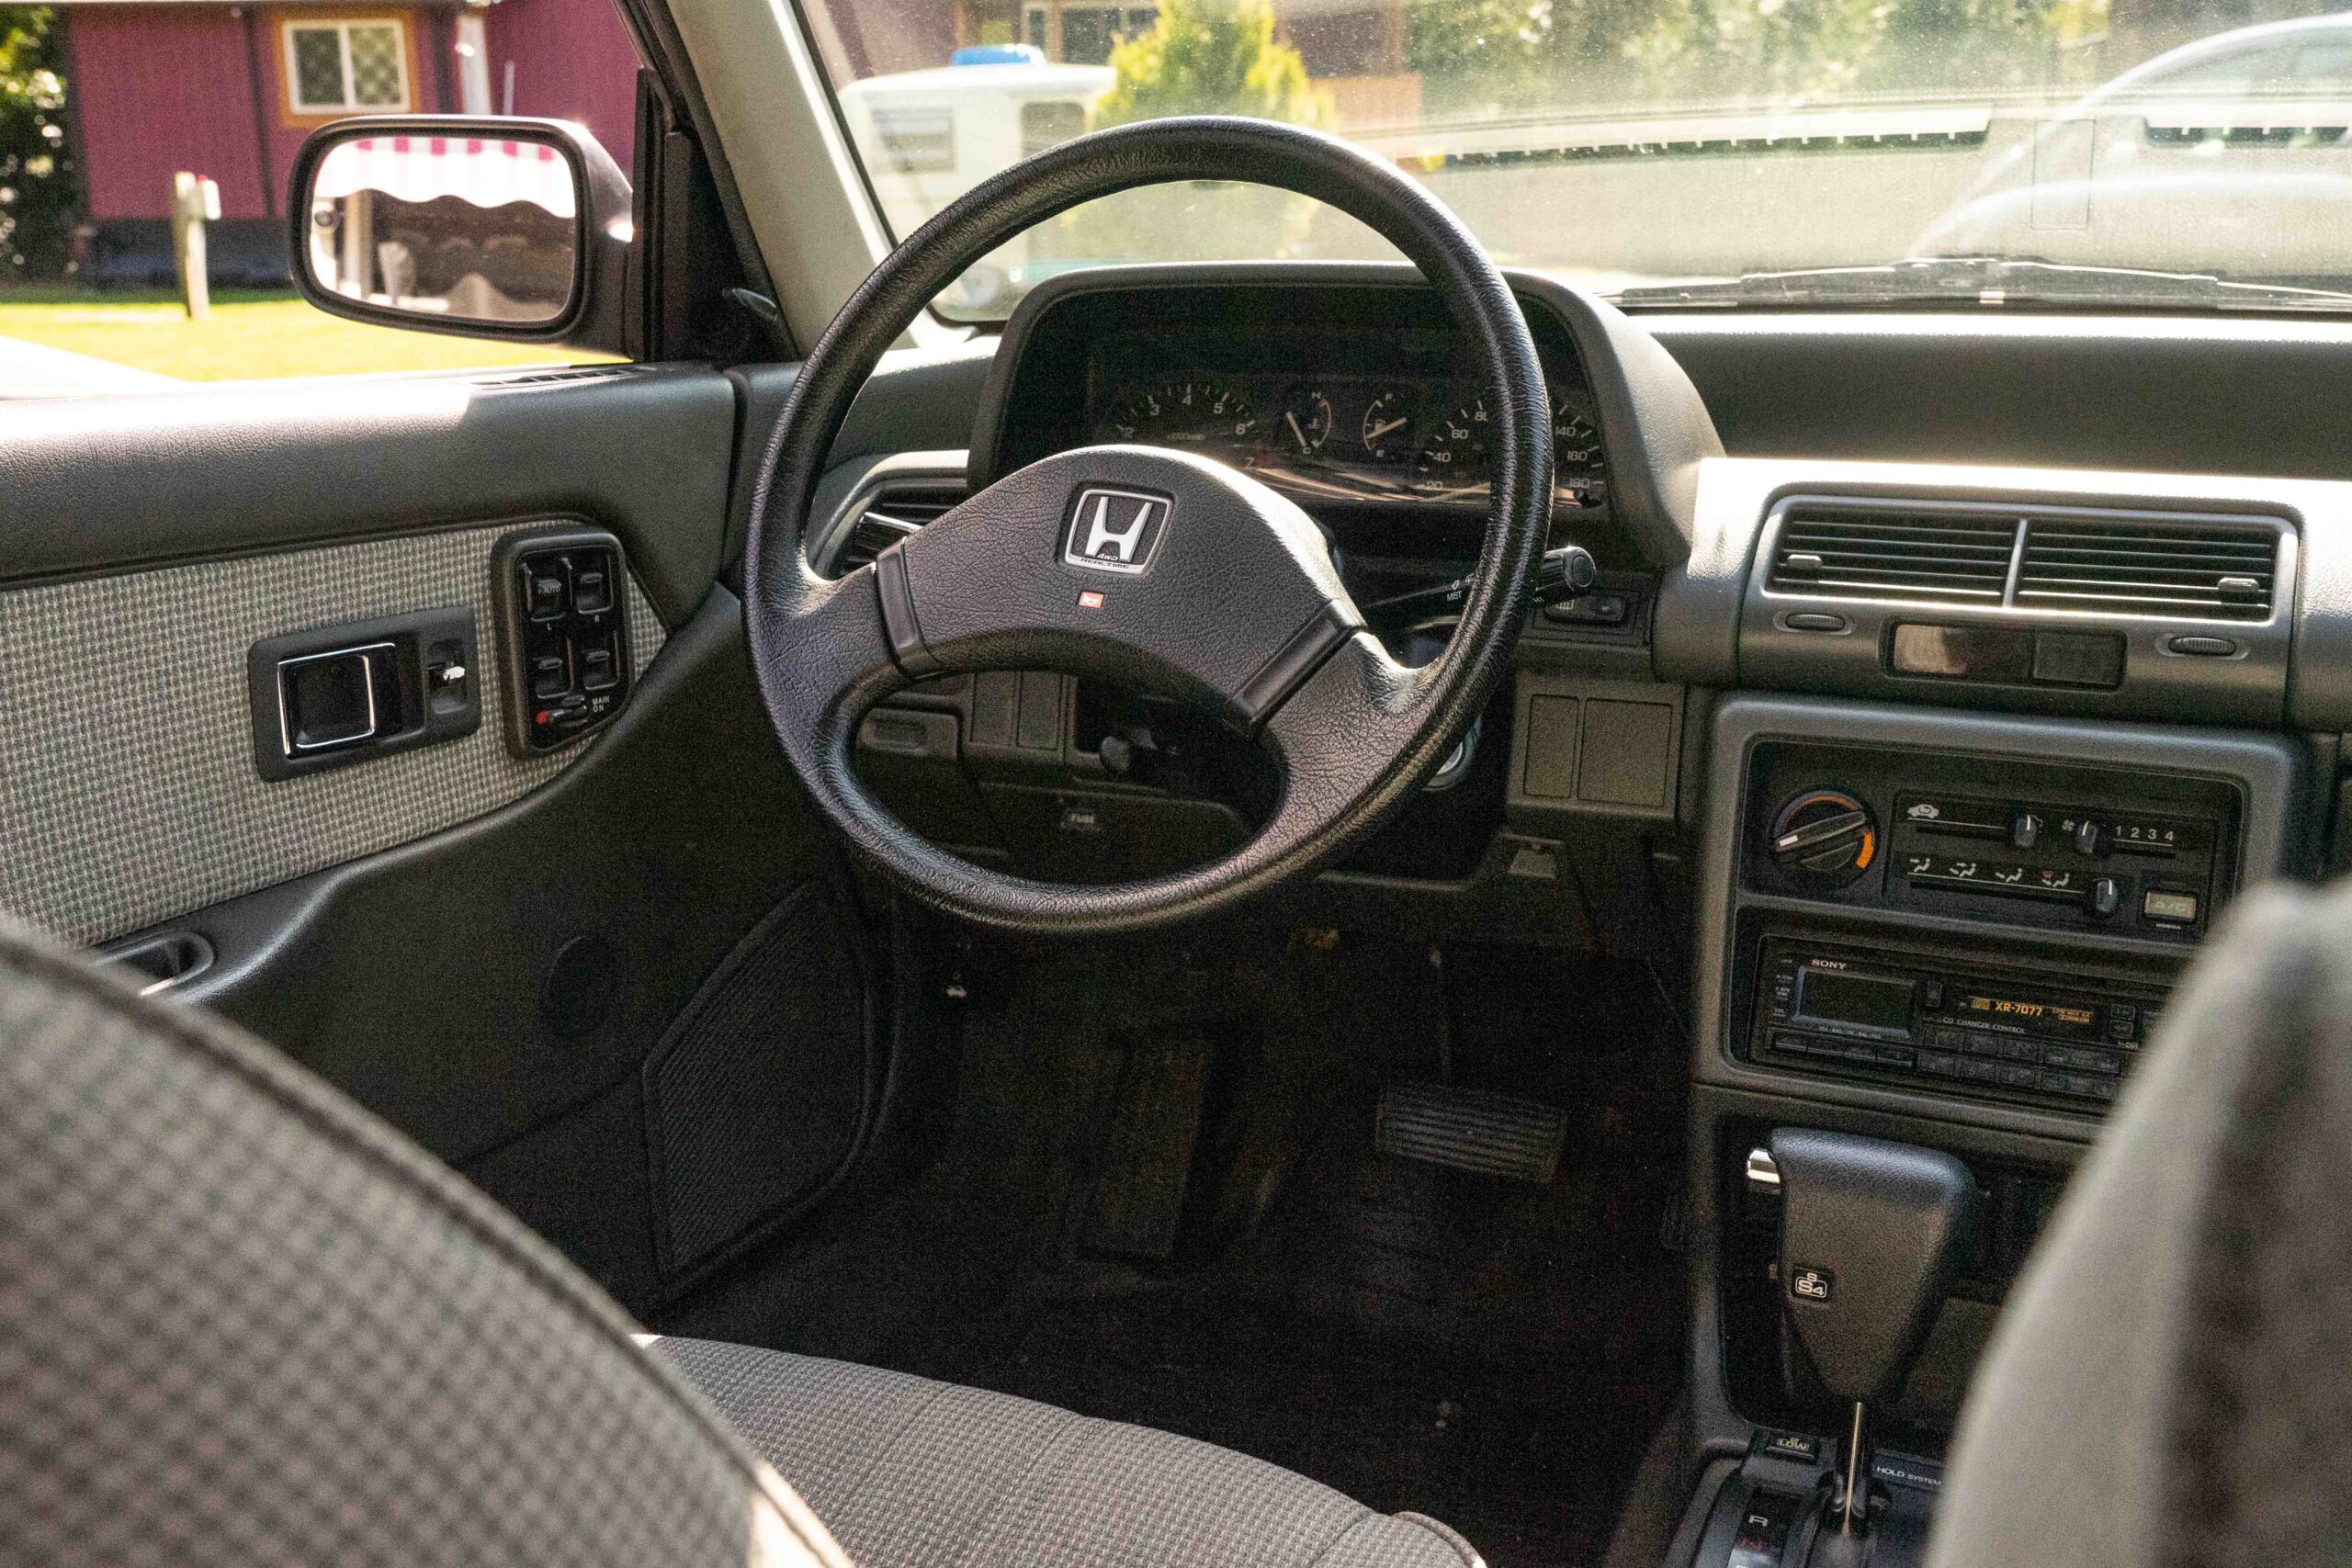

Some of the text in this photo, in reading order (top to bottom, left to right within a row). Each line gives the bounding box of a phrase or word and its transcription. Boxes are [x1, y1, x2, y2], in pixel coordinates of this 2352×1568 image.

[1182, 395, 1192, 406] 4
[1149, 403, 1160, 415] 3
[1214, 402, 1223, 414] 5
[1123, 426, 1135, 438] 2
[1236, 423, 1246, 435] 6
[1452, 429, 1468, 439] 60
[1555, 425, 1577, 437] 140
[1433, 452, 1451, 462] 40
[1567, 450, 1589, 461] 160
[1246, 457, 1255, 468] 7
[1097, 553, 1118, 561] 4WD
[1447, 591, 1462, 602] MIST
[593, 695, 610, 705] MAIN
[593, 705, 605, 713] ON
[2116, 826, 2175, 841] 1 2 3 4
[2155, 900, 2188, 912] A/C
[1812, 959, 1847, 970] SONY
[1995, 1000, 2043, 1017] XR-7077
[1957, 1019, 1990, 1030] CHANGER
[1992, 1023, 2027, 1034] CONTROL
[1877, 1466, 1941, 1486] HOLD SYSTEM
[1748, 1515, 1769, 1527] R
